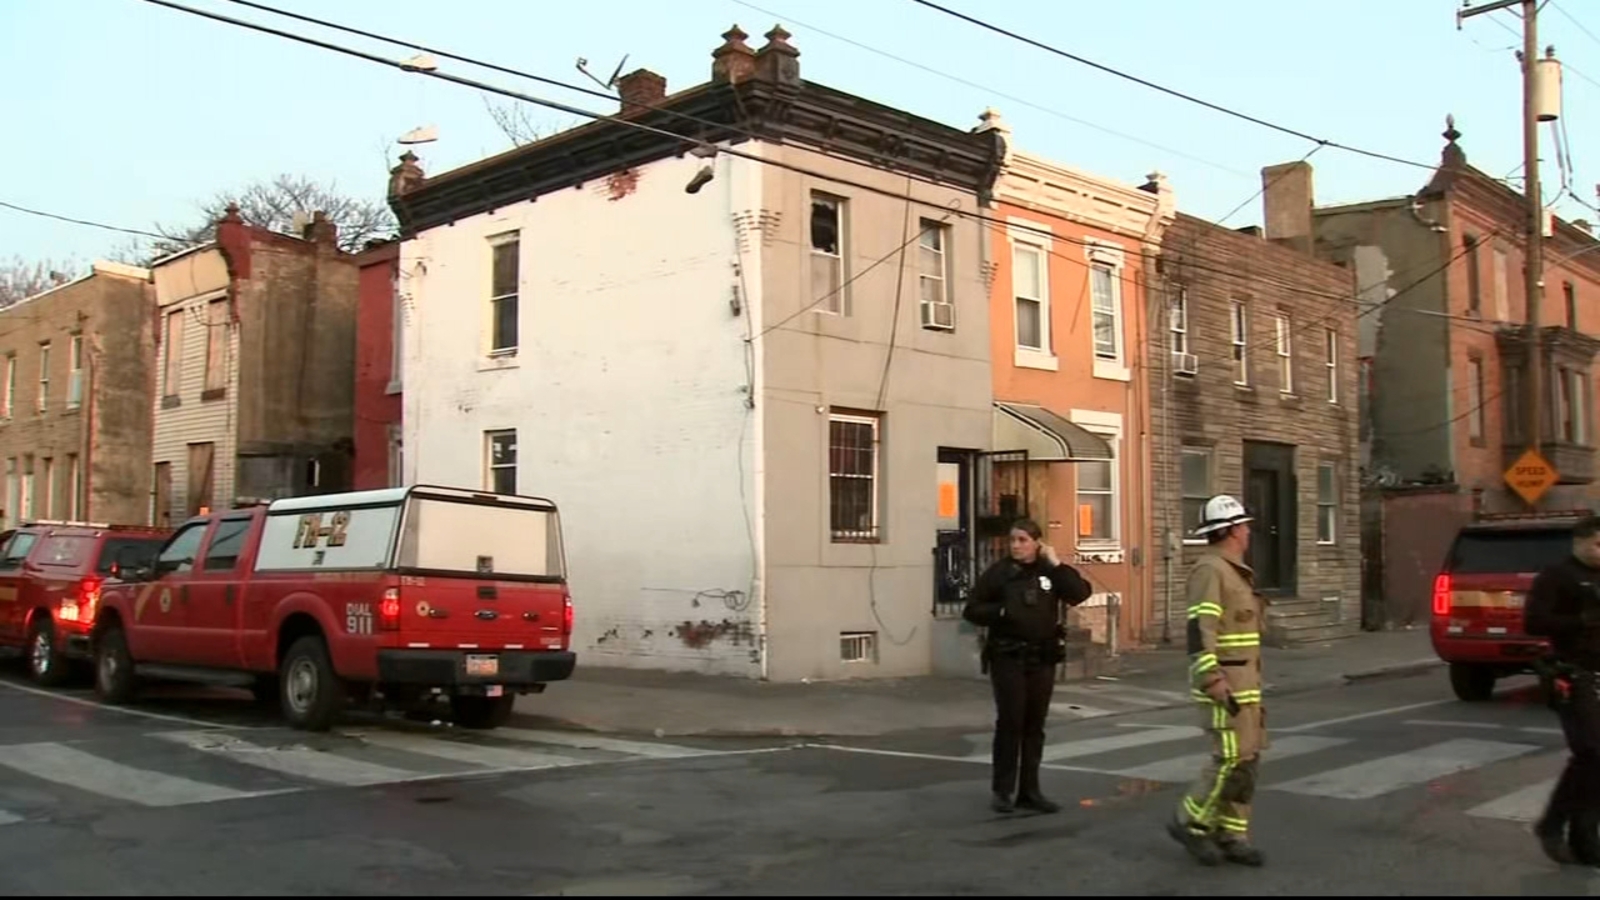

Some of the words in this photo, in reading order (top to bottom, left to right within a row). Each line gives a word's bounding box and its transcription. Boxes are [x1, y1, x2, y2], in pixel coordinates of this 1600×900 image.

[1515, 466, 1546, 476] SPEED
[346, 602, 372, 616] DIAL
[346, 615, 373, 635] 911
